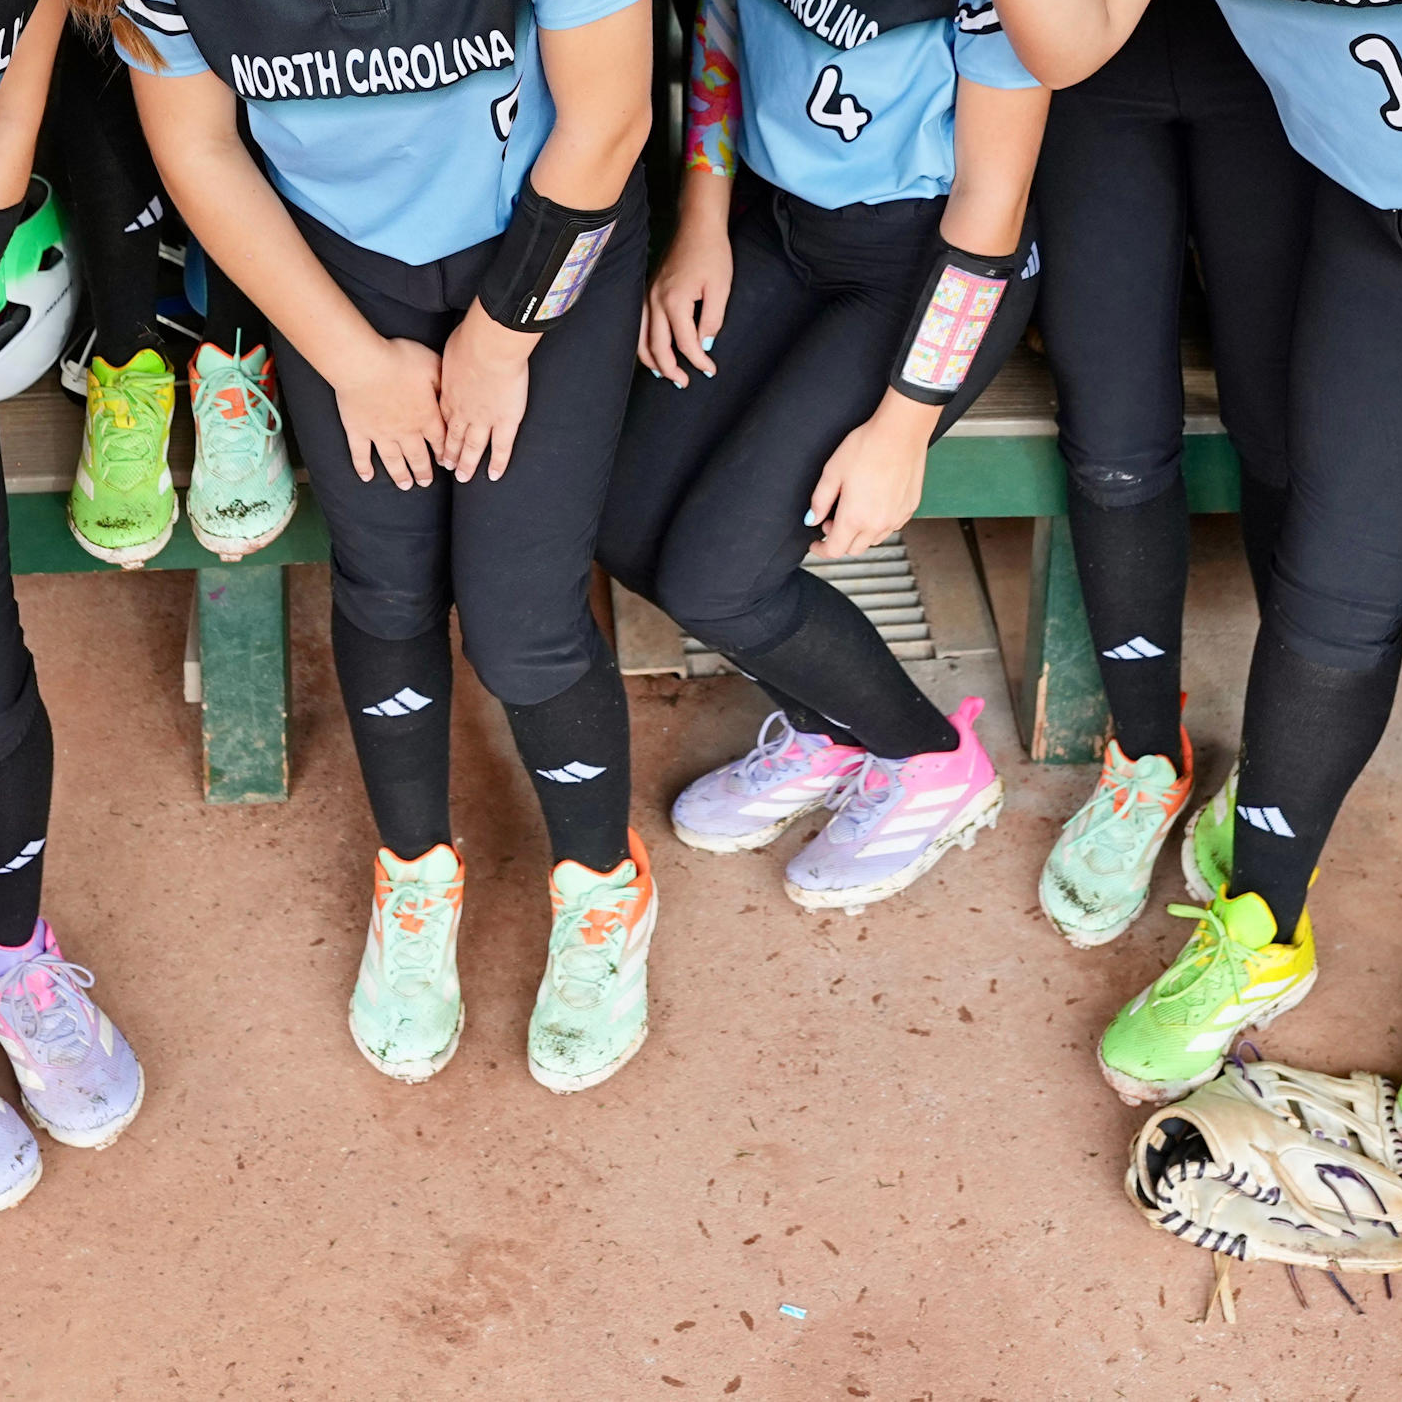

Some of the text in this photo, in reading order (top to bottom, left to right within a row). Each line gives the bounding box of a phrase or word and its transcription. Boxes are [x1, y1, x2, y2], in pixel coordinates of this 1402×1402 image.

[231, 29, 516, 99] NORTH CAROLINA
[806, 64, 872, 143] 4
